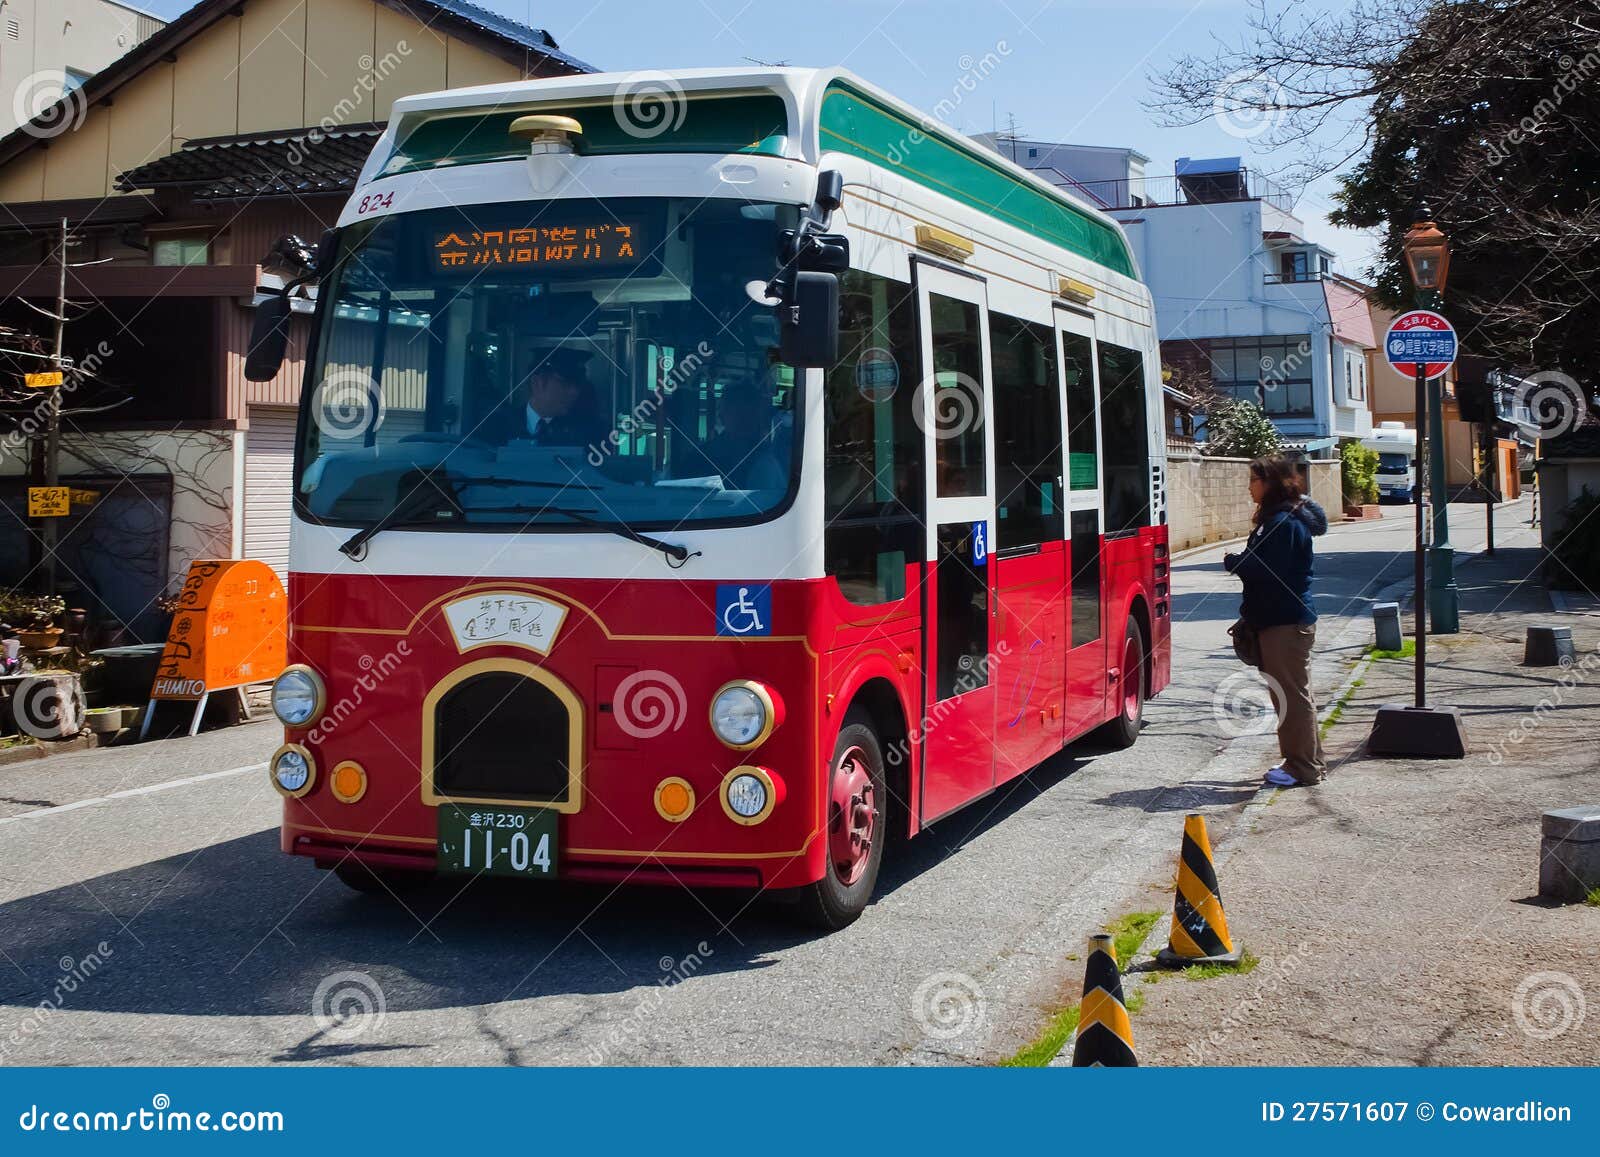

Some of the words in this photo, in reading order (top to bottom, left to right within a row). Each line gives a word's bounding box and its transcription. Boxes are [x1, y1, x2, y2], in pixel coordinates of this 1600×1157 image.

[358, 191, 394, 214] 824
[435, 224, 634, 266] 金沢周遊バス
[1401, 316, 1440, 329] 北鉄バス
[154, 679, 205, 697] HIMITO
[463, 829, 551, 873] 11-04
